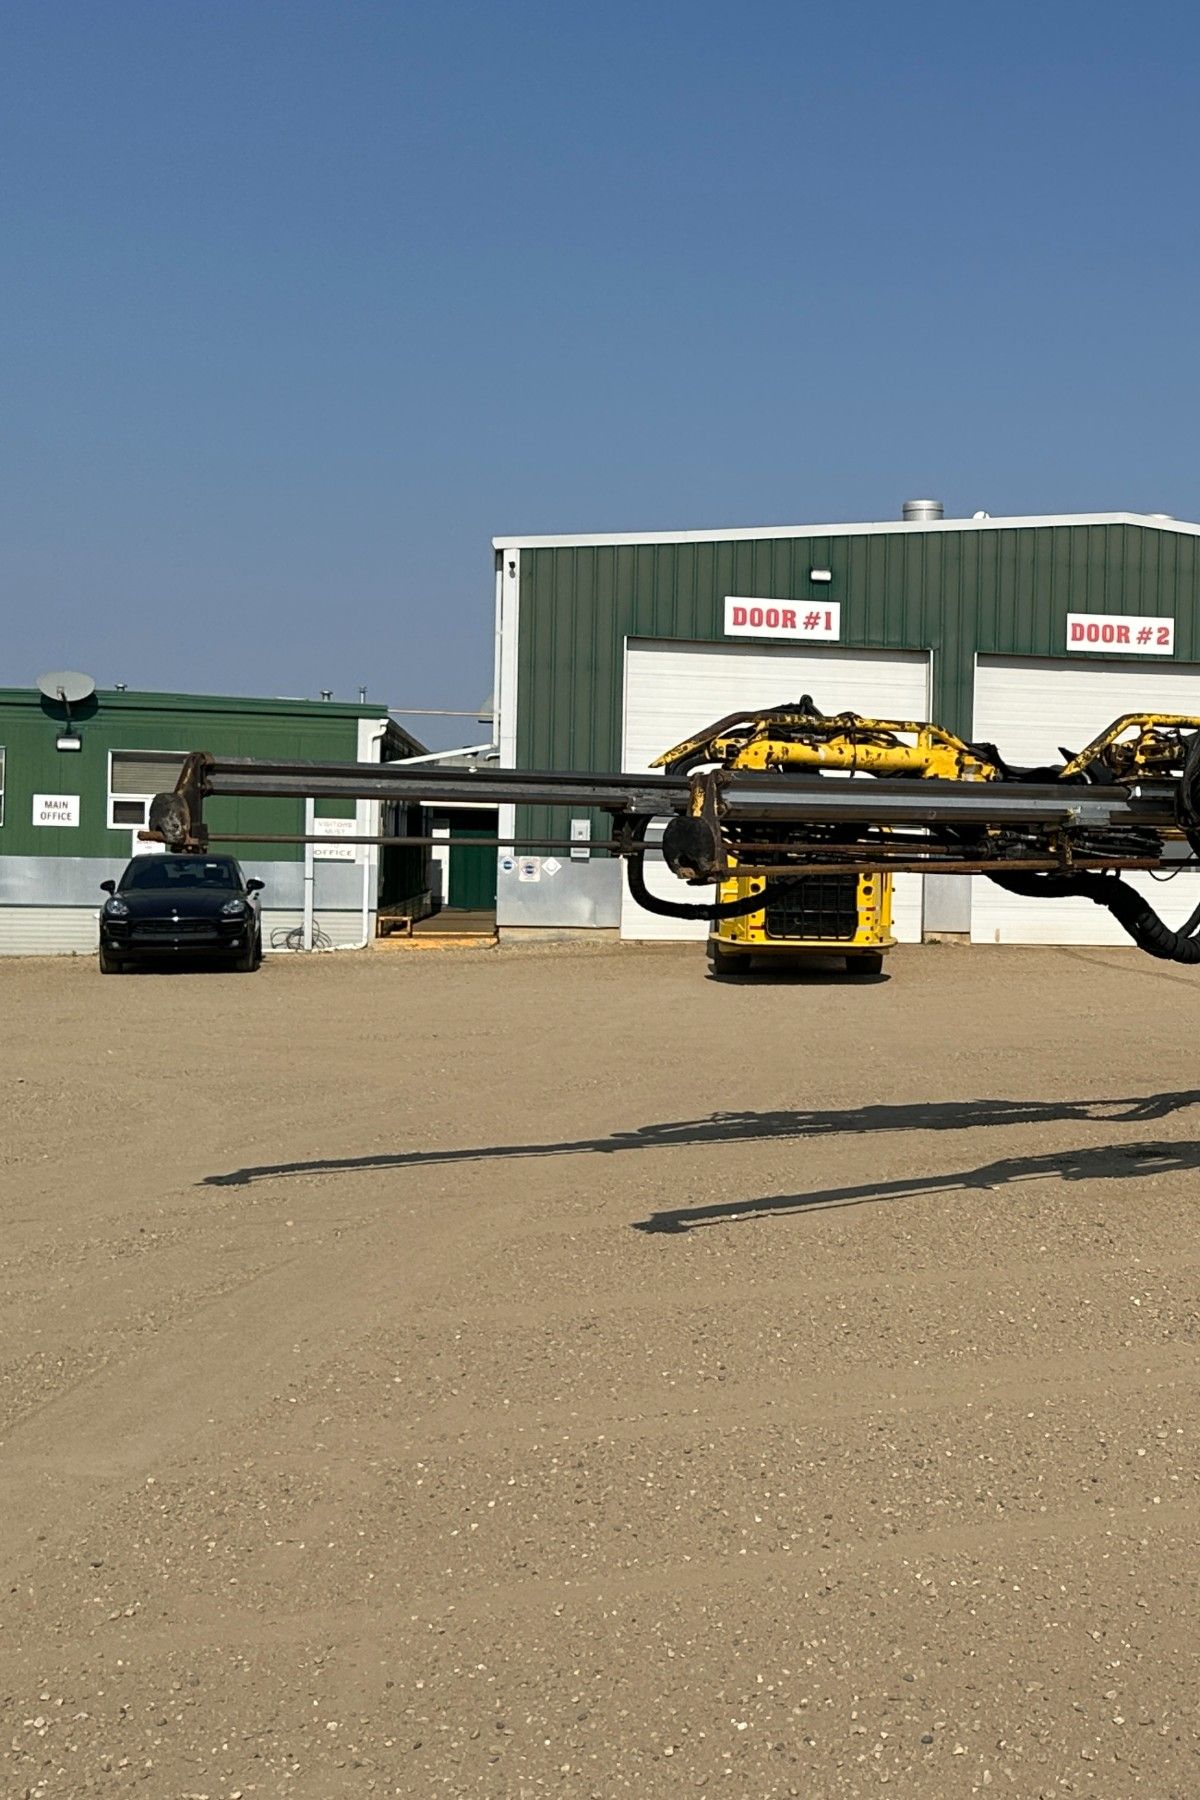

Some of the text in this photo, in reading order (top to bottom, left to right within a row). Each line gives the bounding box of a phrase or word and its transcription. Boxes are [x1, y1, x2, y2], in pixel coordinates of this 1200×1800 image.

[733, 607, 832, 630] DOOR #1
[1071, 623, 1170, 645] DOOR #2
[44, 800, 69, 809] MAIN
[40, 811, 72, 821] OFFICE
[313, 849, 352, 857] OFFICE
